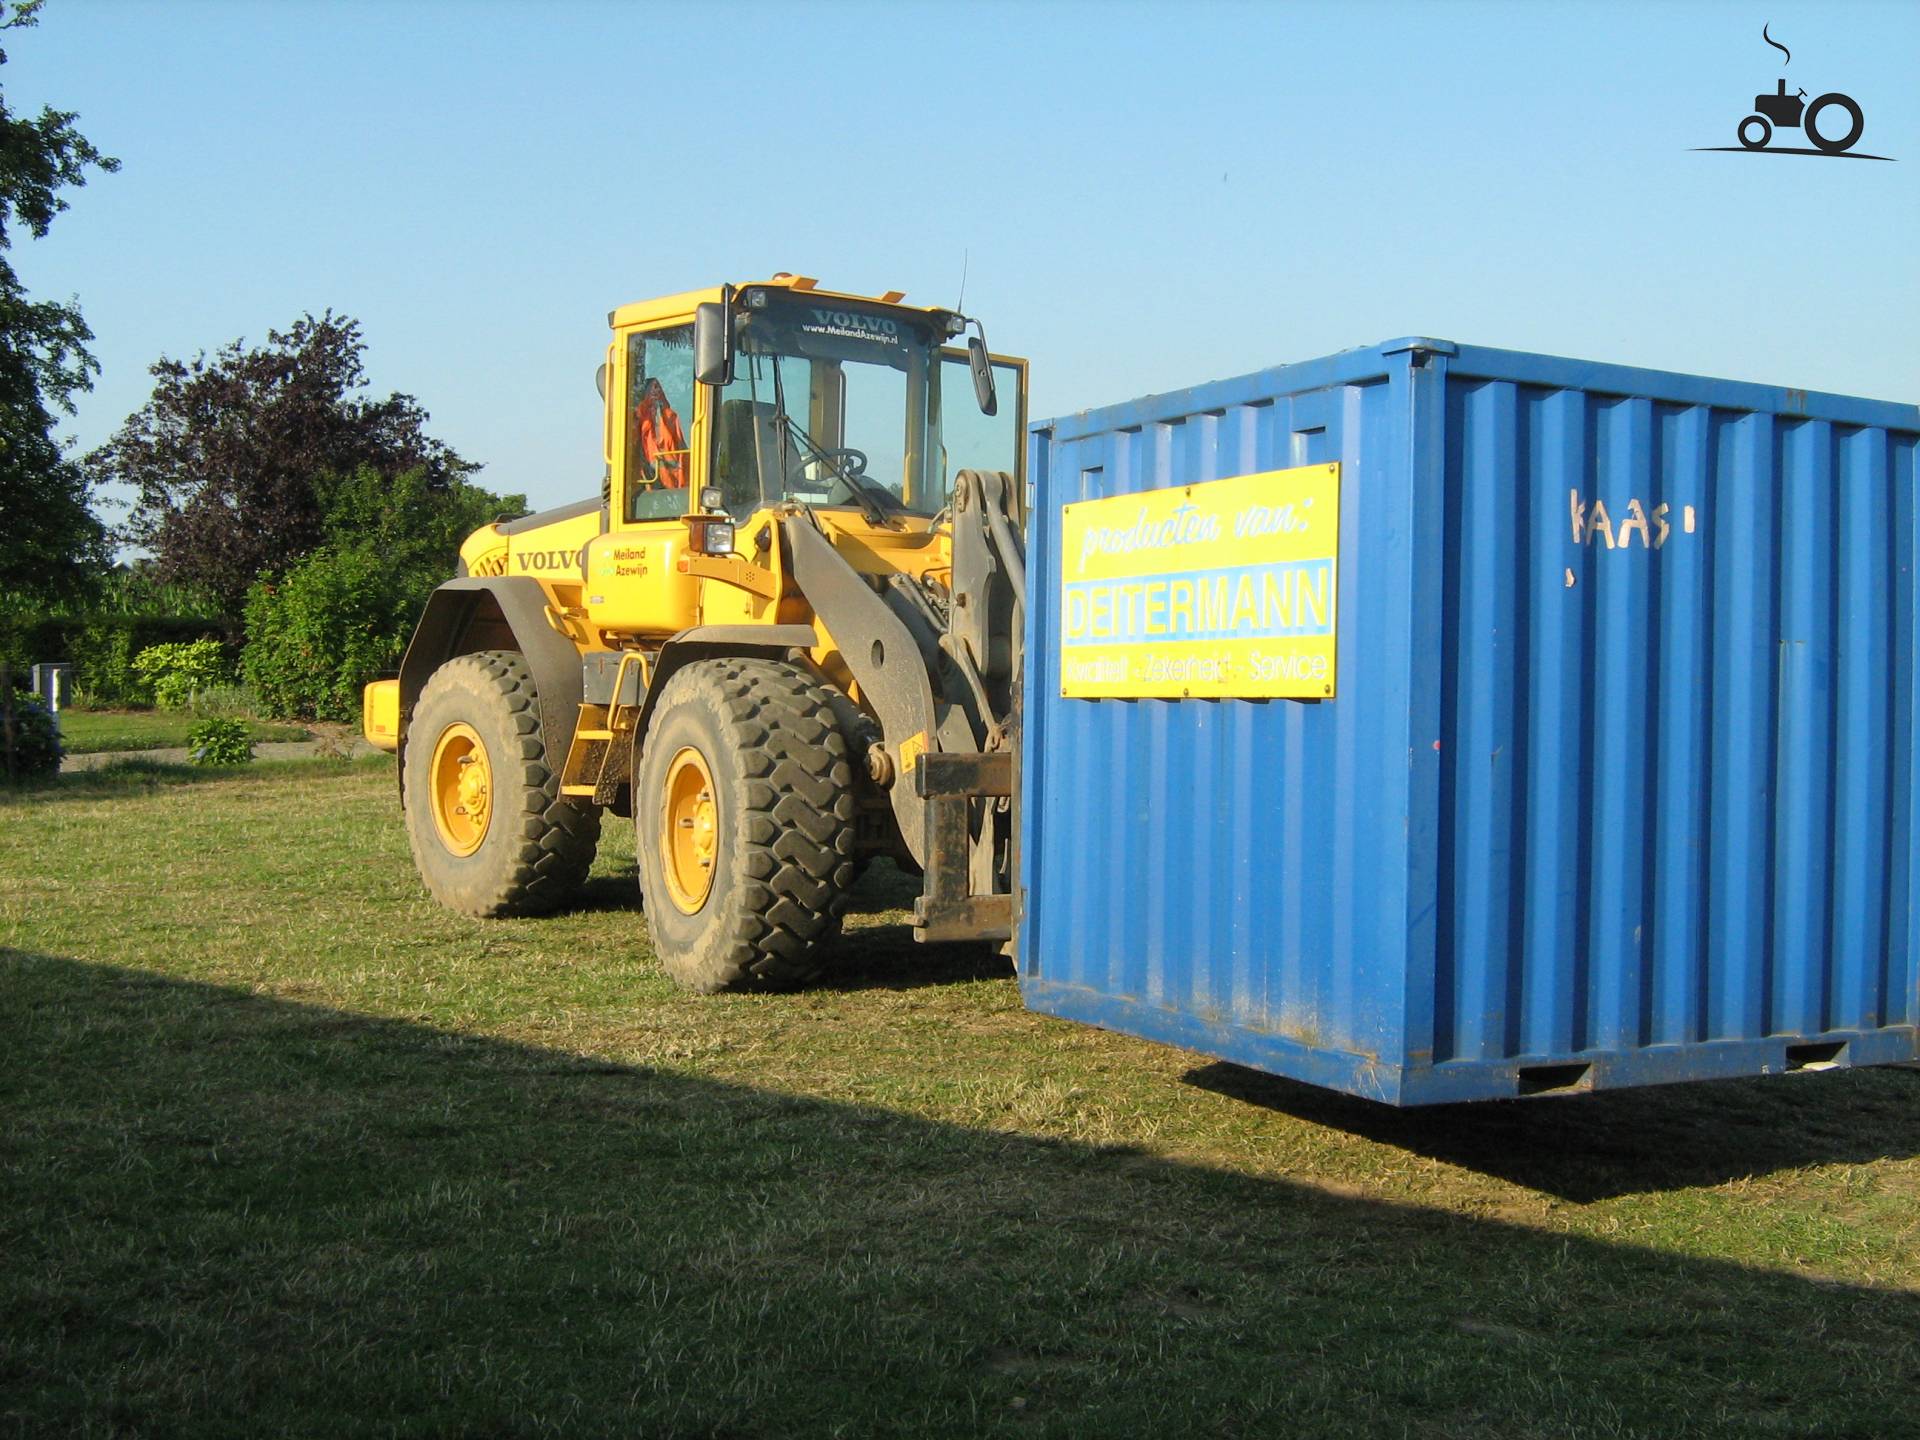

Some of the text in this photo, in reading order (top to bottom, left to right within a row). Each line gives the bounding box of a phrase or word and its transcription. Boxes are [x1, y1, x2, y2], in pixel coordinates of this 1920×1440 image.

[802, 323, 899, 345] www.MeilandAzewijn.nl
[812, 308, 897, 335] VOLVO
[1076, 497, 1314, 573] producten van:
[613, 546, 646, 561] Meiland
[615, 563, 648, 579] Azewijn
[1066, 566, 1329, 639] DEITERMANN
[1248, 649, 1328, 682] Service
